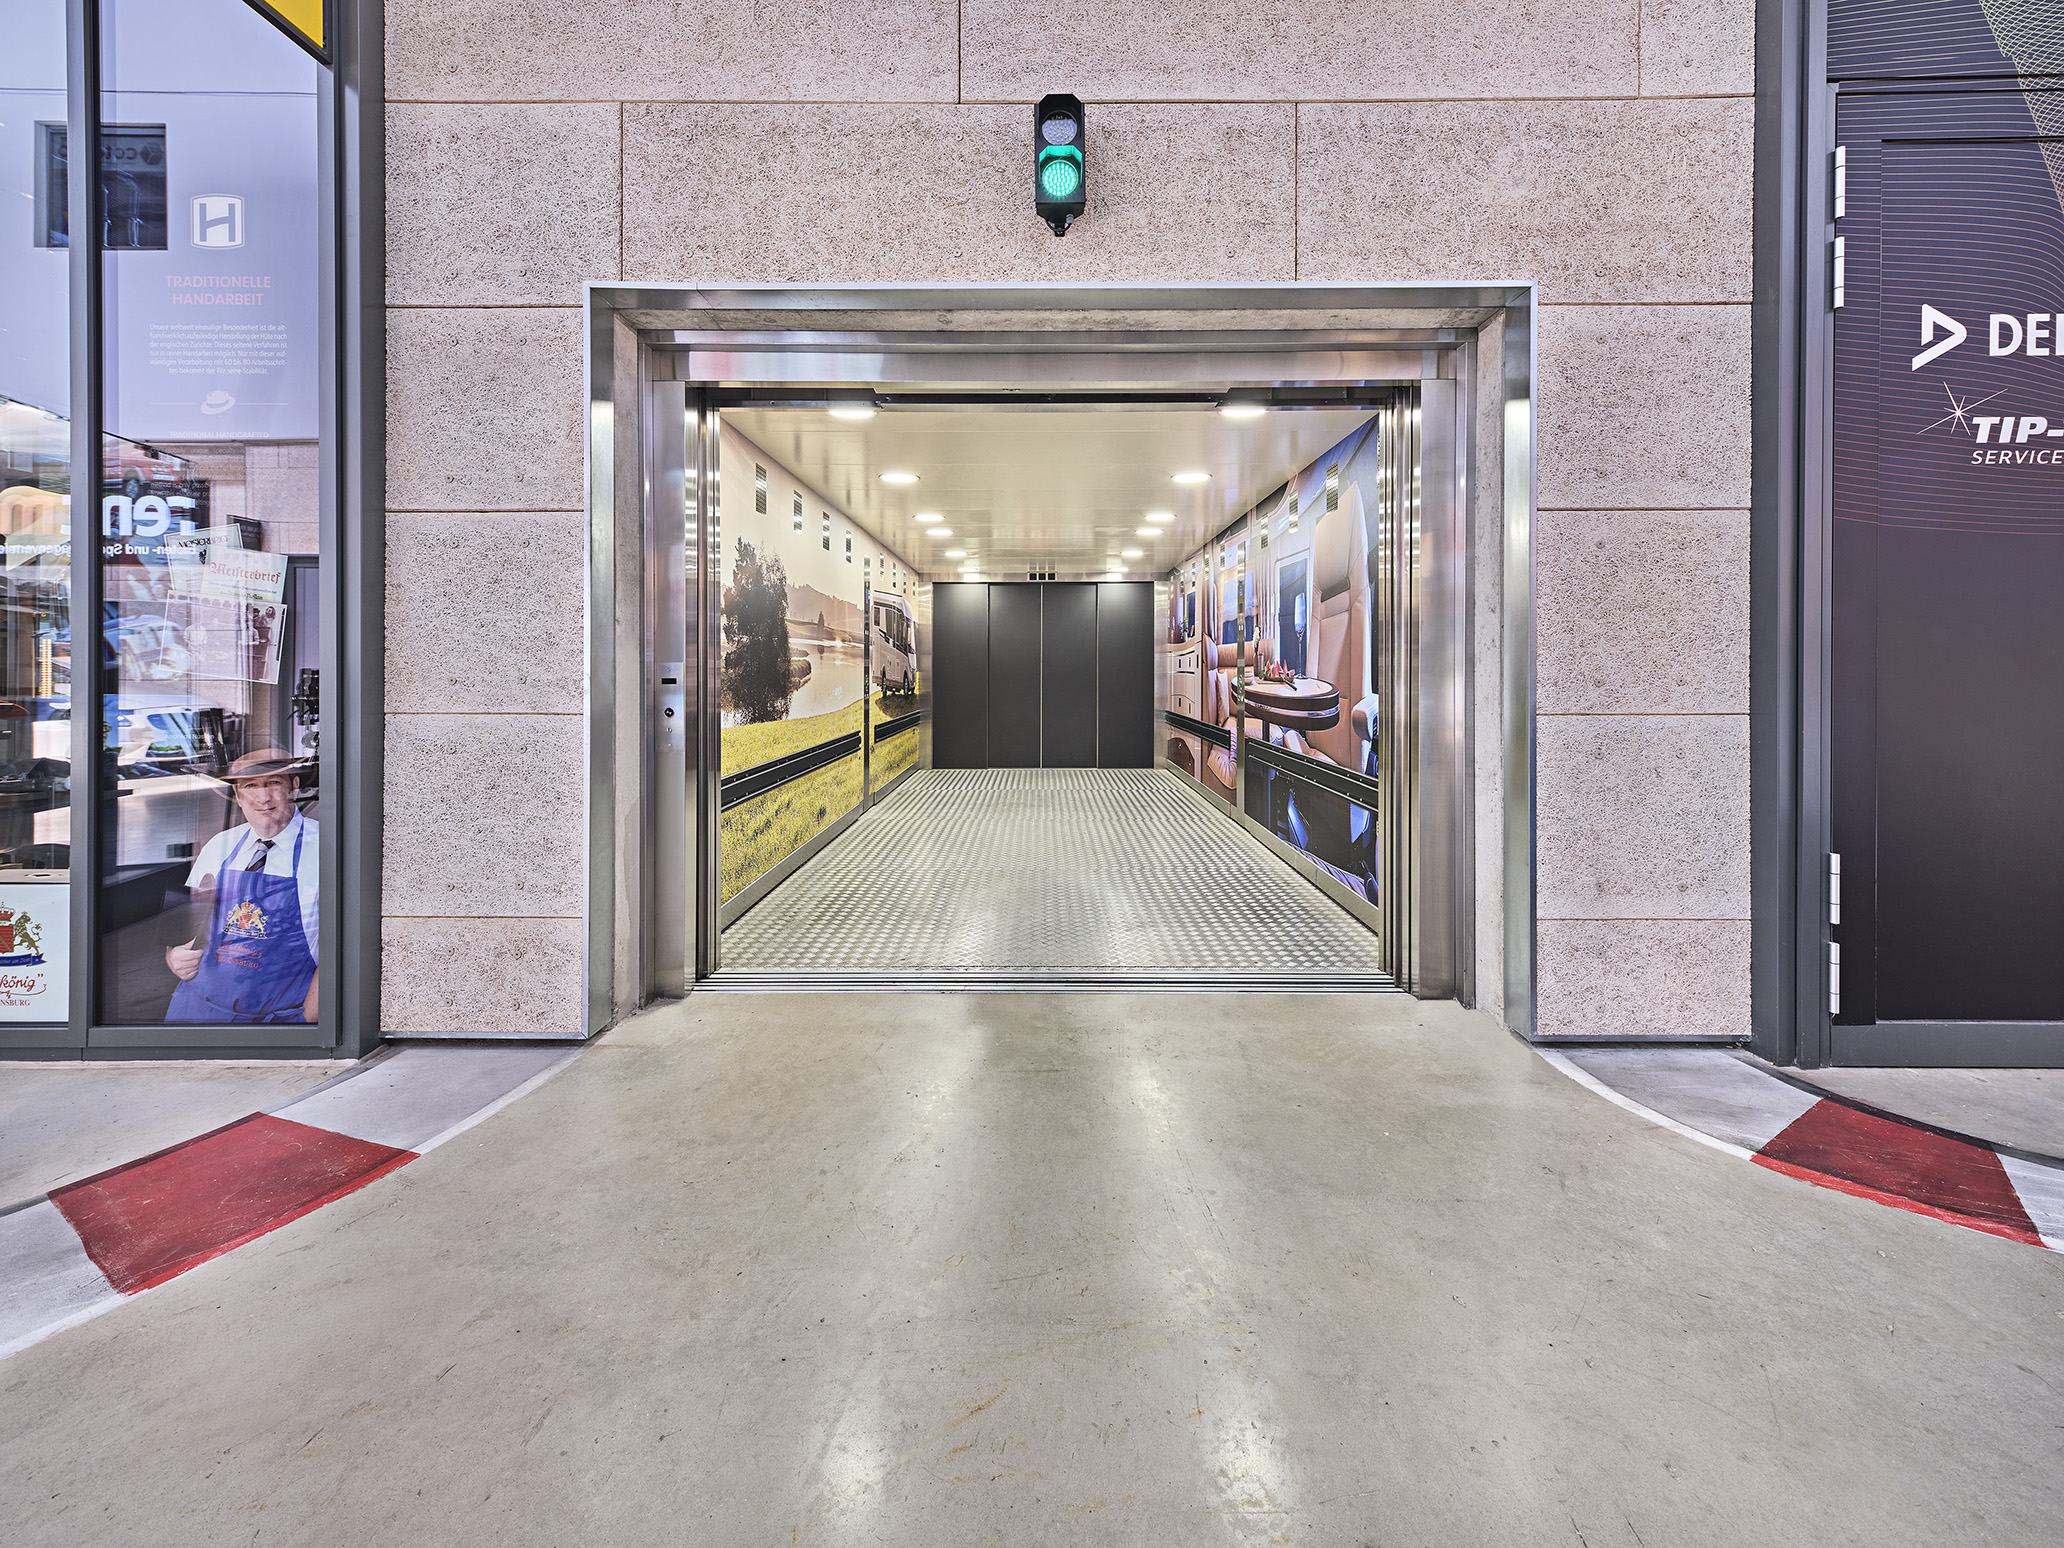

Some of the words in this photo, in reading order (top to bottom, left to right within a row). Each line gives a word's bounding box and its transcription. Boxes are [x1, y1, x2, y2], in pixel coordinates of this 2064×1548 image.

[164, 275, 272, 288] TRADITIONELLE
[172, 293, 264, 305] HANDARBEIT
[168, 431, 216, 439] TRADITIONAL
[217, 431, 269, 439] HANDCRAFTED
[1971, 450, 2063, 465] SERVICE
